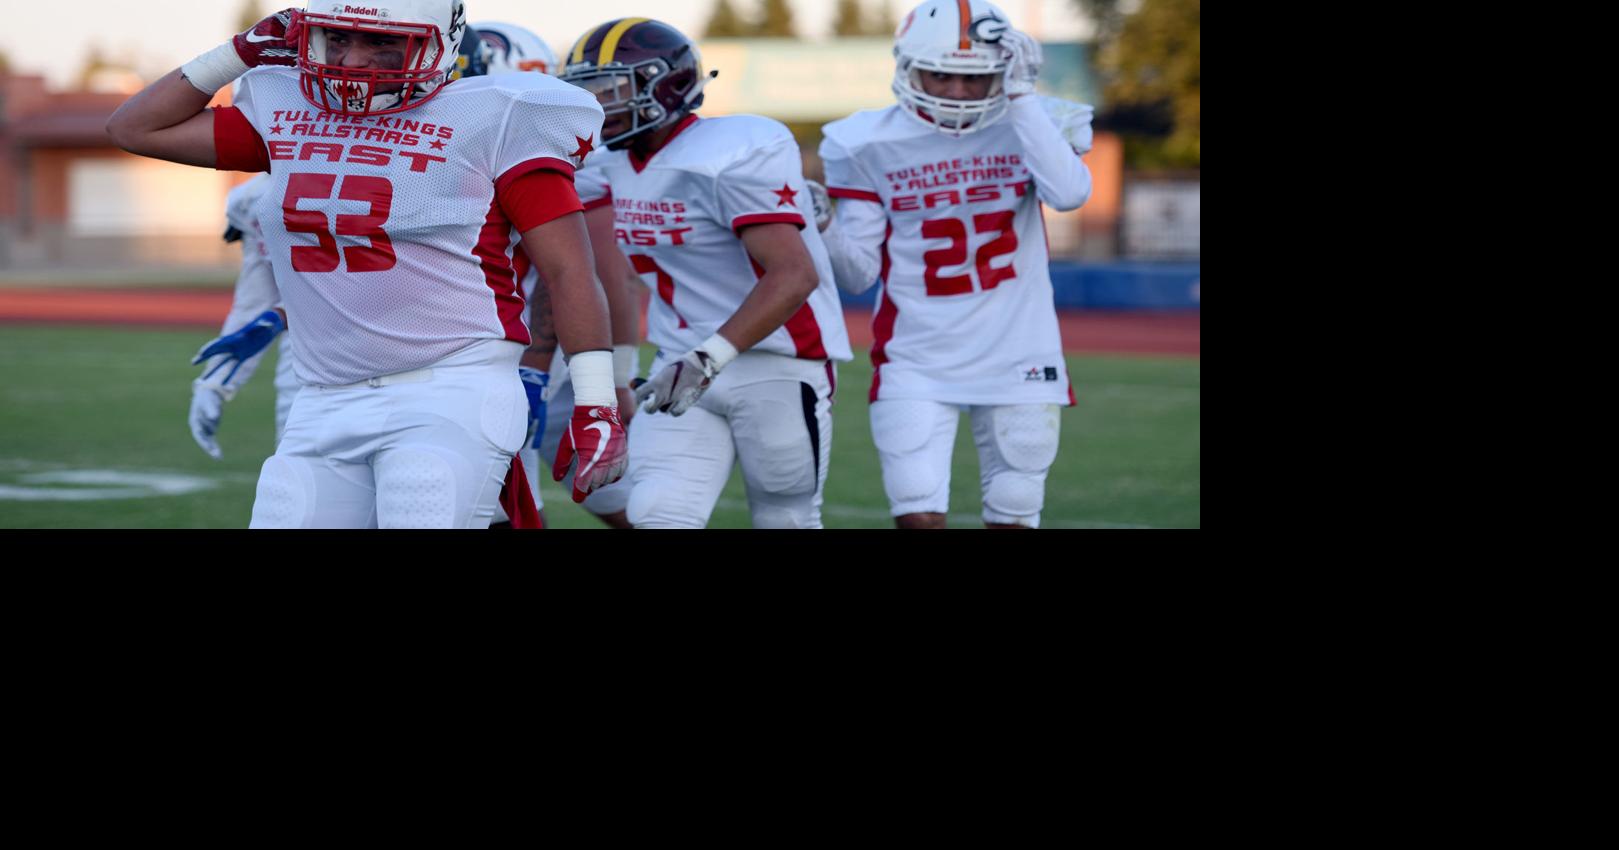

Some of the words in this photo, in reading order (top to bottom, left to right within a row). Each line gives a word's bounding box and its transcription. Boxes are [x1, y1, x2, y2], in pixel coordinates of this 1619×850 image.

[344, 5, 378, 17] Riddell
[290, 123, 420, 146] ALLSTARS
[268, 141, 447, 173] EAST
[886, 155, 1021, 182] TULARE-KING
[908, 166, 1014, 190] ALLSTARS
[891, 180, 1032, 212] EAST
[282, 173, 397, 273] 53
[614, 227, 693, 246] AST
[921, 210, 1018, 296] 22
